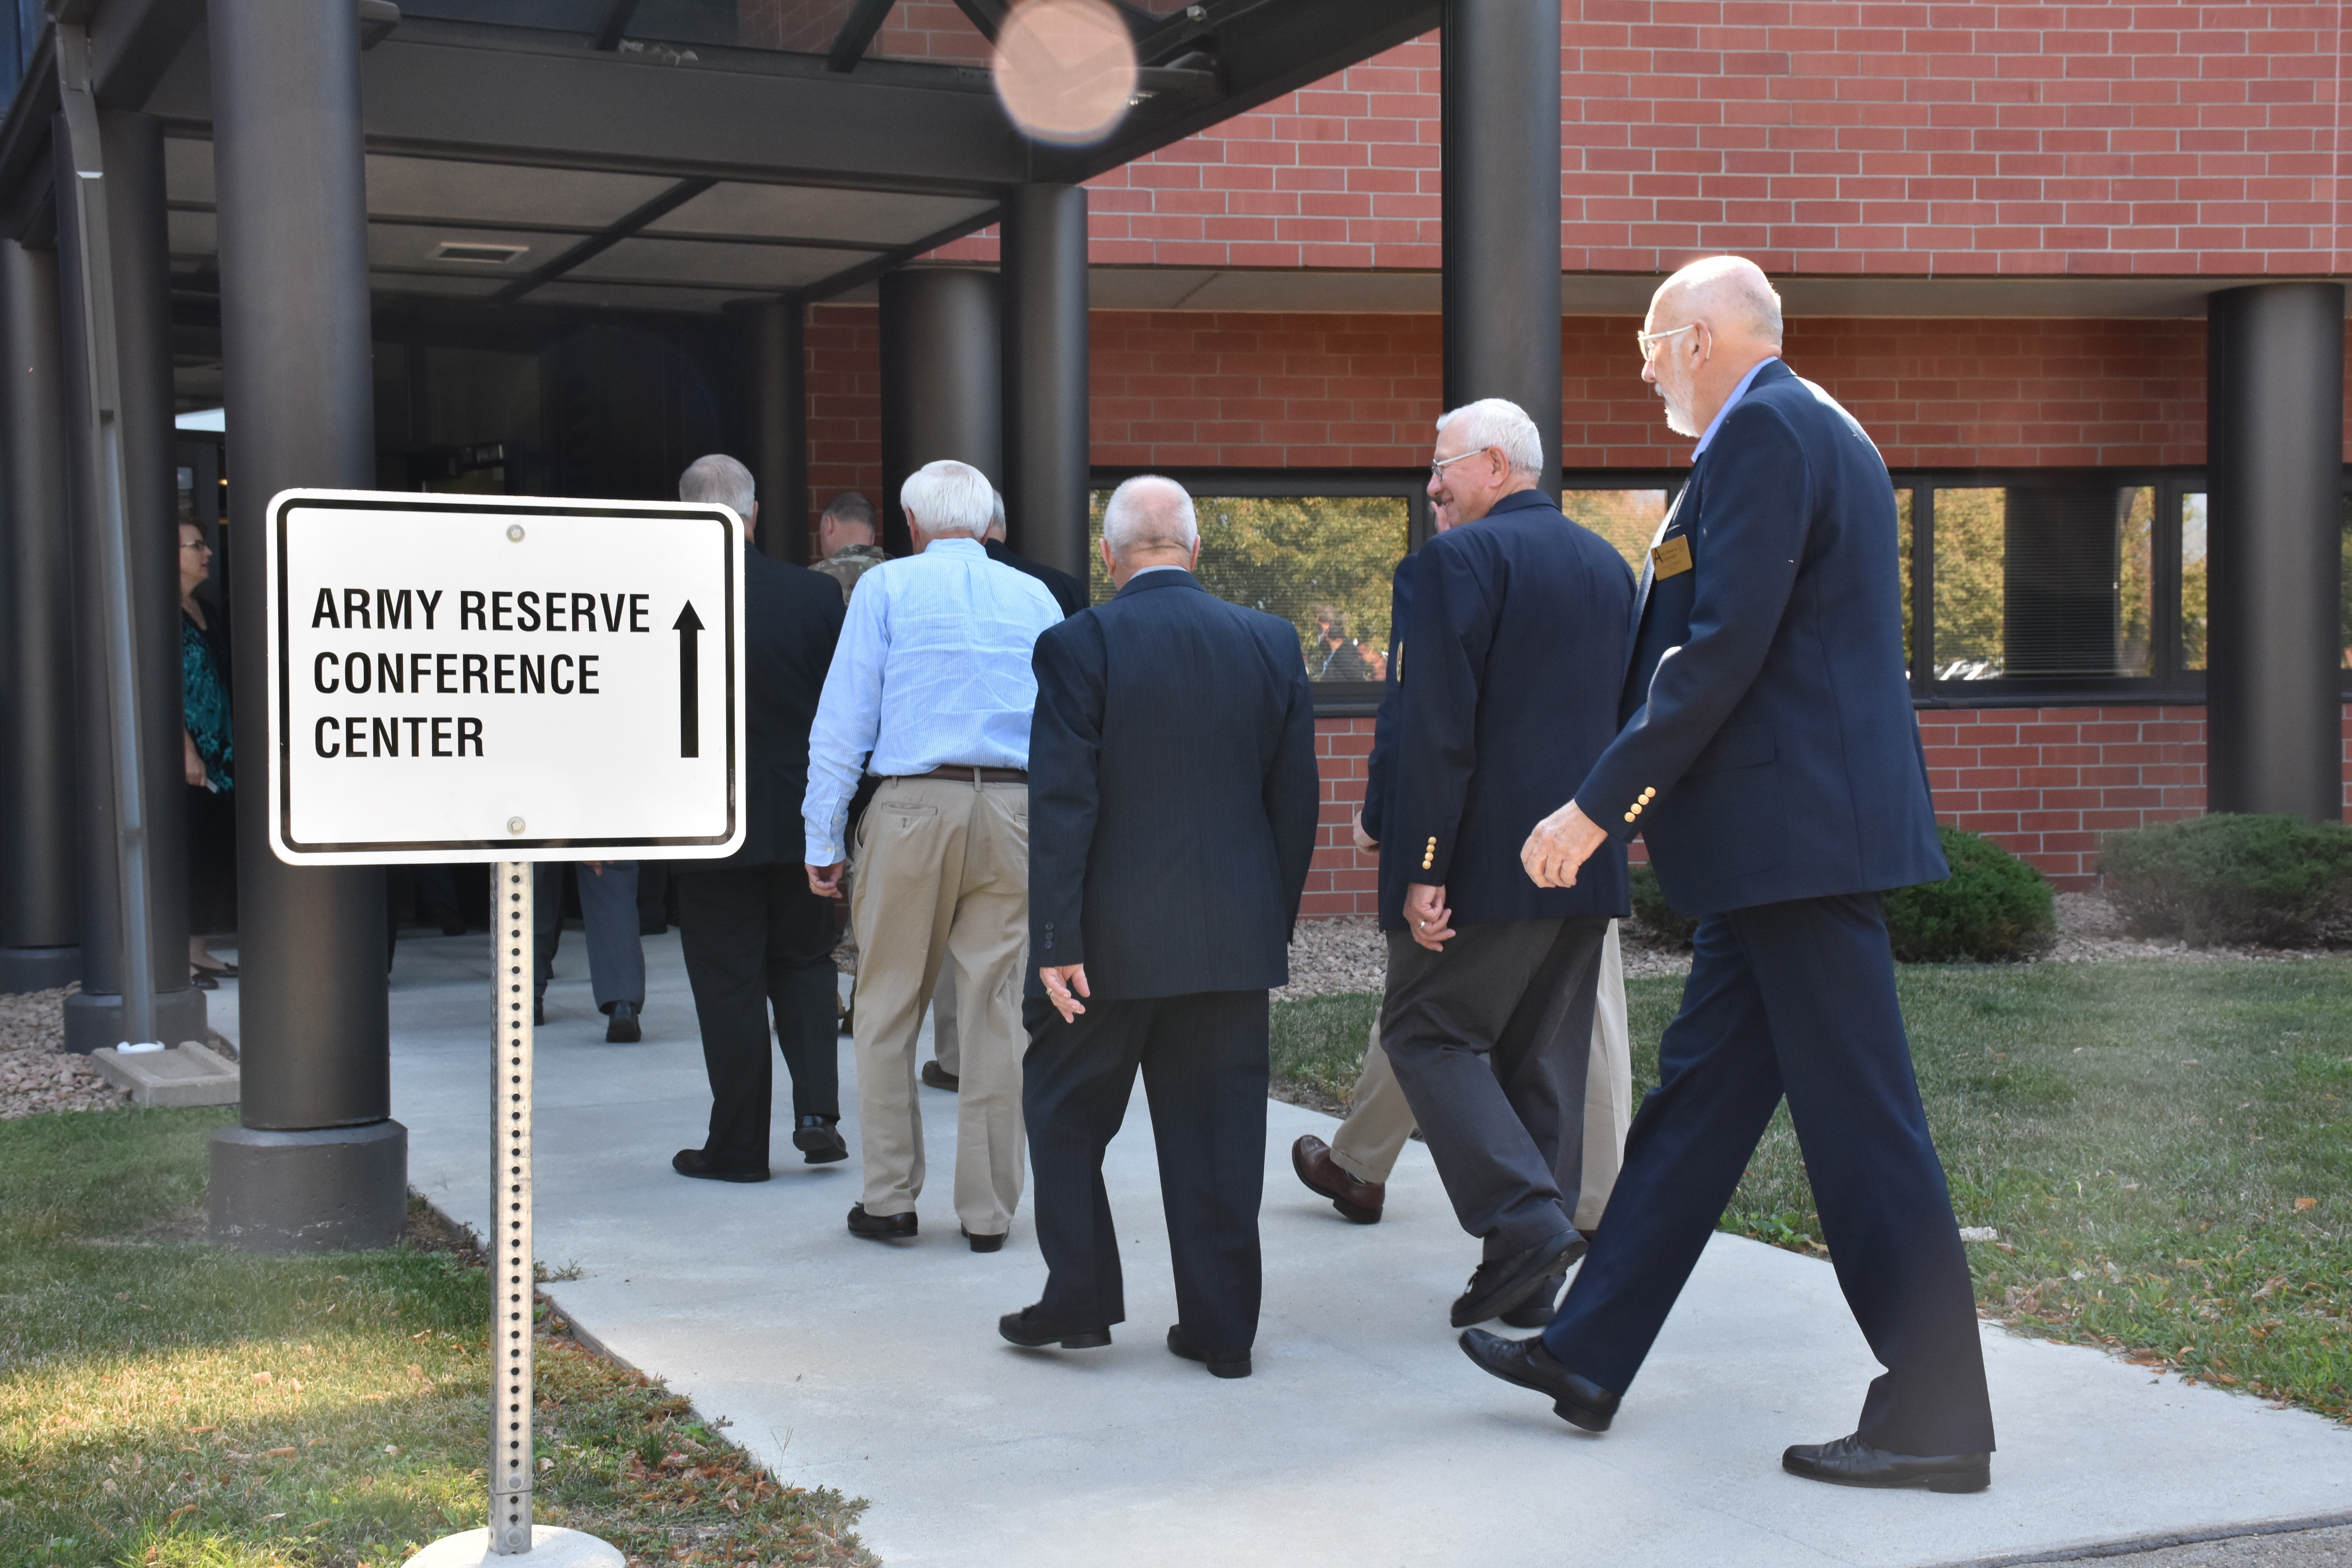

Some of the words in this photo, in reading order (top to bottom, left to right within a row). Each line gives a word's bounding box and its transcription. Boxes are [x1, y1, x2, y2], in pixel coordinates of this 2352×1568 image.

[312, 588, 443, 630] ARMY
[461, 591, 650, 632] RESERVE
[314, 652, 600, 694] CONFERENCE
[315, 716, 484, 758] CENTER
